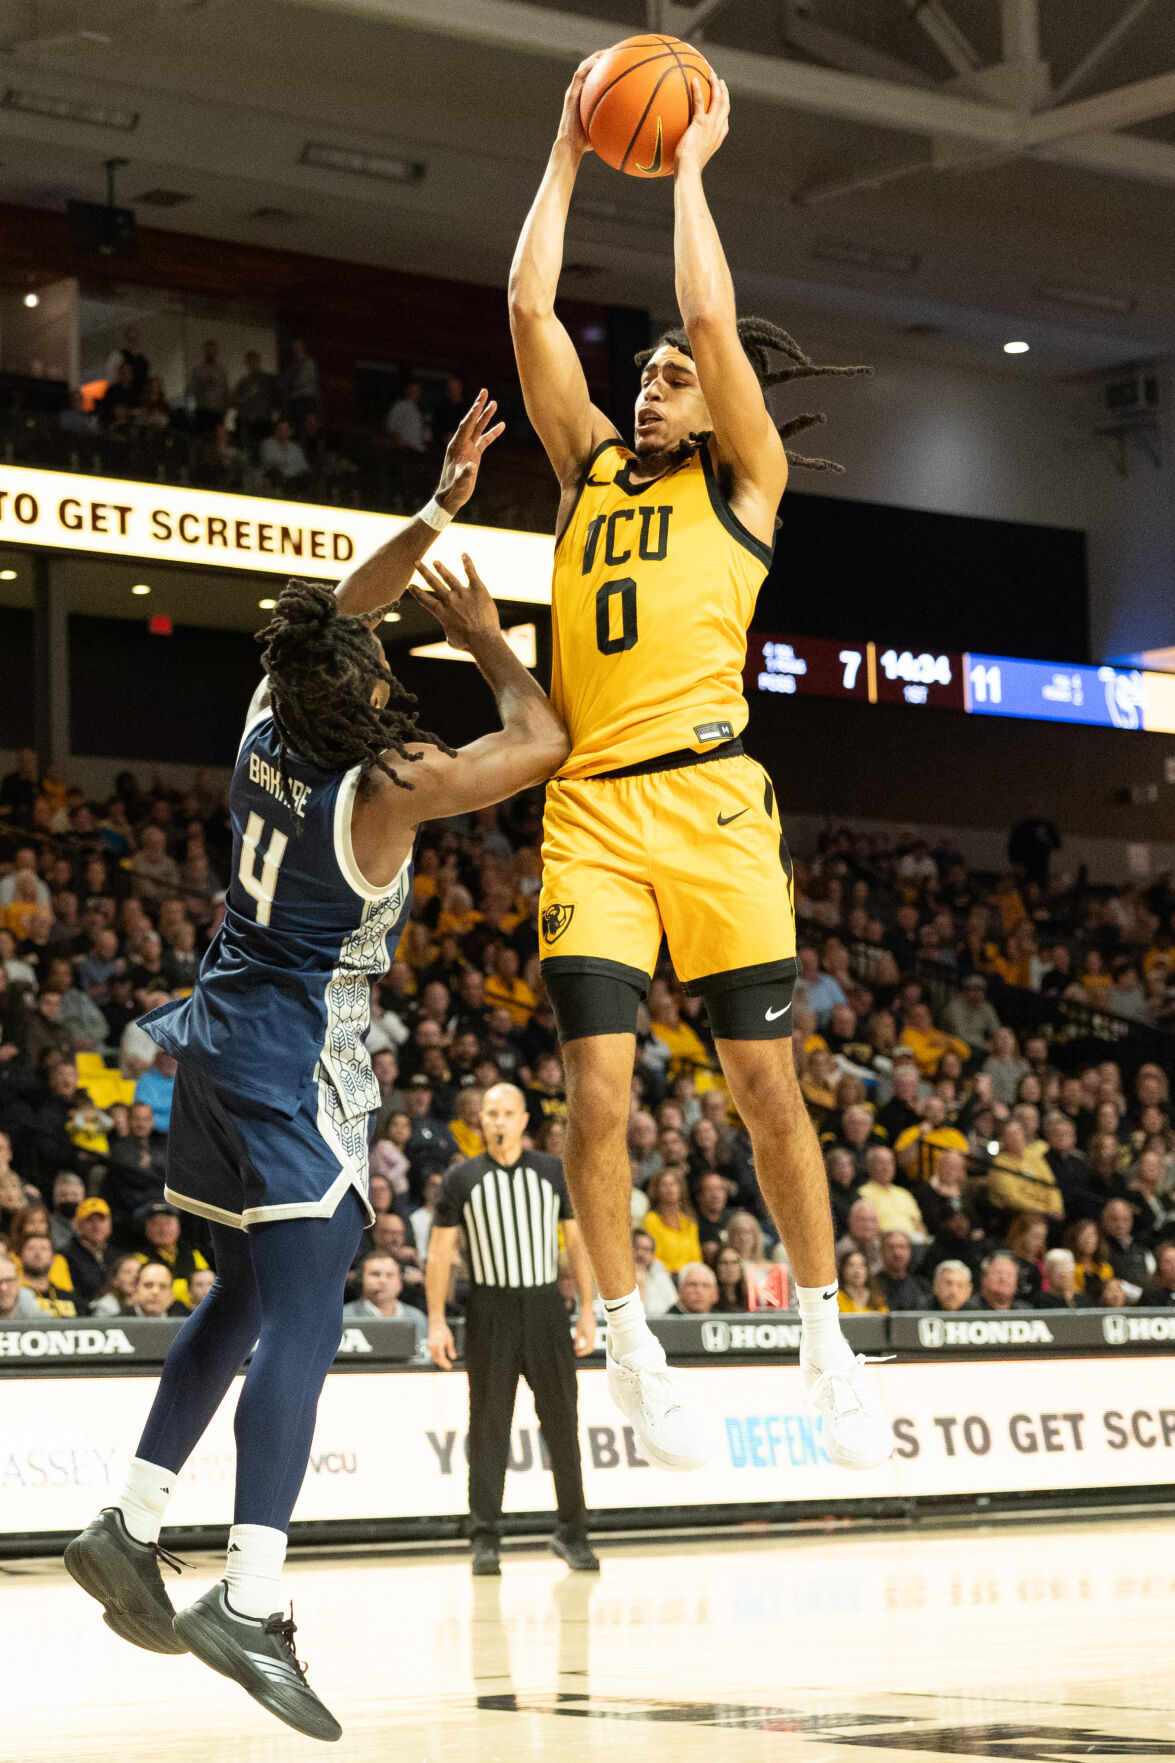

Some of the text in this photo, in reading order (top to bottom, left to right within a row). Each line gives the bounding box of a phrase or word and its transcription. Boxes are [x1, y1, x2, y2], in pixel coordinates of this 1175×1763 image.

[58, 498, 133, 535] GET
[151, 510, 354, 562] SCREENED
[596, 577, 638, 656] 0
[839, 650, 862, 690] 7
[969, 664, 1002, 704] 11
[238, 810, 288, 926] 4
[0, 1329, 135, 1357] HONDA
[730, 1324, 803, 1349] HON
[944, 1320, 1054, 1345] HONDA
[425, 1427, 553, 1475] YU
[588, 1426, 650, 1469] BE
[933, 1415, 991, 1457] TO
[1009, 1412, 1085, 1454] GET
